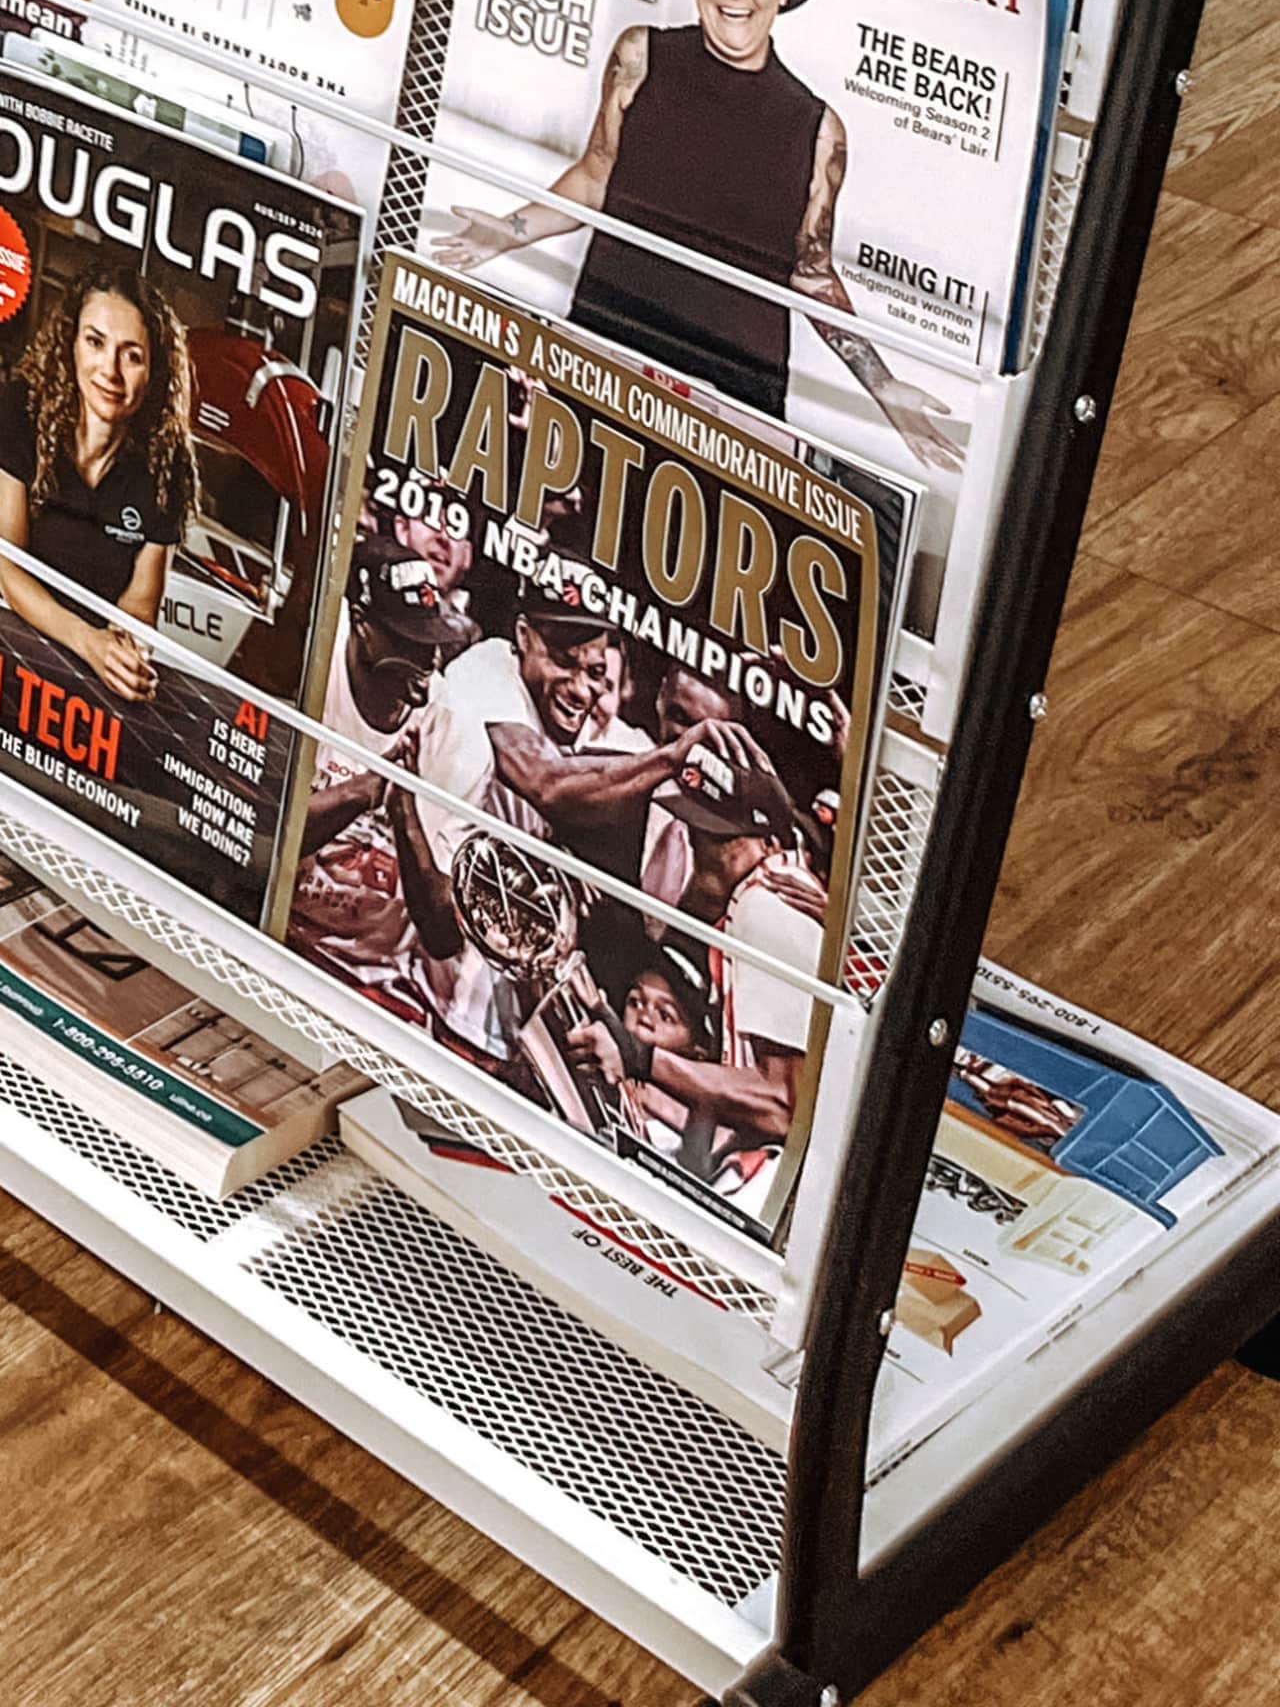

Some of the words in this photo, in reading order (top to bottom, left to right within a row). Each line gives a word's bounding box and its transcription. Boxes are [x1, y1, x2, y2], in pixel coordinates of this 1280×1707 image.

[856, 54, 907, 91] ARE
[914, 73, 992, 121] BACK!
[857, 22, 905, 61] THE
[912, 42, 997, 91] BEARS
[844, 77, 921, 117] Welcoming
[925, 106, 977, 135] Season
[981, 126, 991, 140] 2
[893, 115, 909, 129] of
[912, 120, 957, 145] Bears'
[960, 137, 988, 157] Lair
[841, 265, 917, 306] Indigenous
[922, 298, 973, 328] women
[857, 242, 937, 294] BRING
[944, 276, 976, 310] IT!
[888, 303, 916, 324] take
[920, 317, 938, 333] on
[942, 326, 971, 346] tech
[392, 267, 520, 358] MACLEAN'S
[530, 335, 546, 370] A
[548, 344, 624, 413] SPECIAL
[628, 385, 801, 509] COMMEMORATIVE
[805, 480, 864, 548] ISSUE
[384, 327, 847, 688] RAPTORS
[373, 468, 471, 542] 2019
[482, 519, 568, 590] NBA
[581, 571, 837, 747] CHAMPIONS
[16, 666, 123, 781] TECH
[213, 718, 228, 739] IS
[229, 729, 266, 765] HERE
[234, 699, 269, 741] AI
[25, 742, 64, 781] BLUE
[67, 768, 141, 827] ECONOMY
[164, 753, 257, 826] IMMIGRATION:
[208, 738, 227, 763] TO
[228, 751, 263, 785] STAY
[178, 807, 200, 835] WE
[202, 824, 251, 867] DOING?
[192, 794, 226, 827] HOW
[226, 814, 254, 847] ARE
[572, 1229, 602, 1248] OF
[600, 1246, 647, 1278] BEST
[644, 1272, 680, 1299] THE
